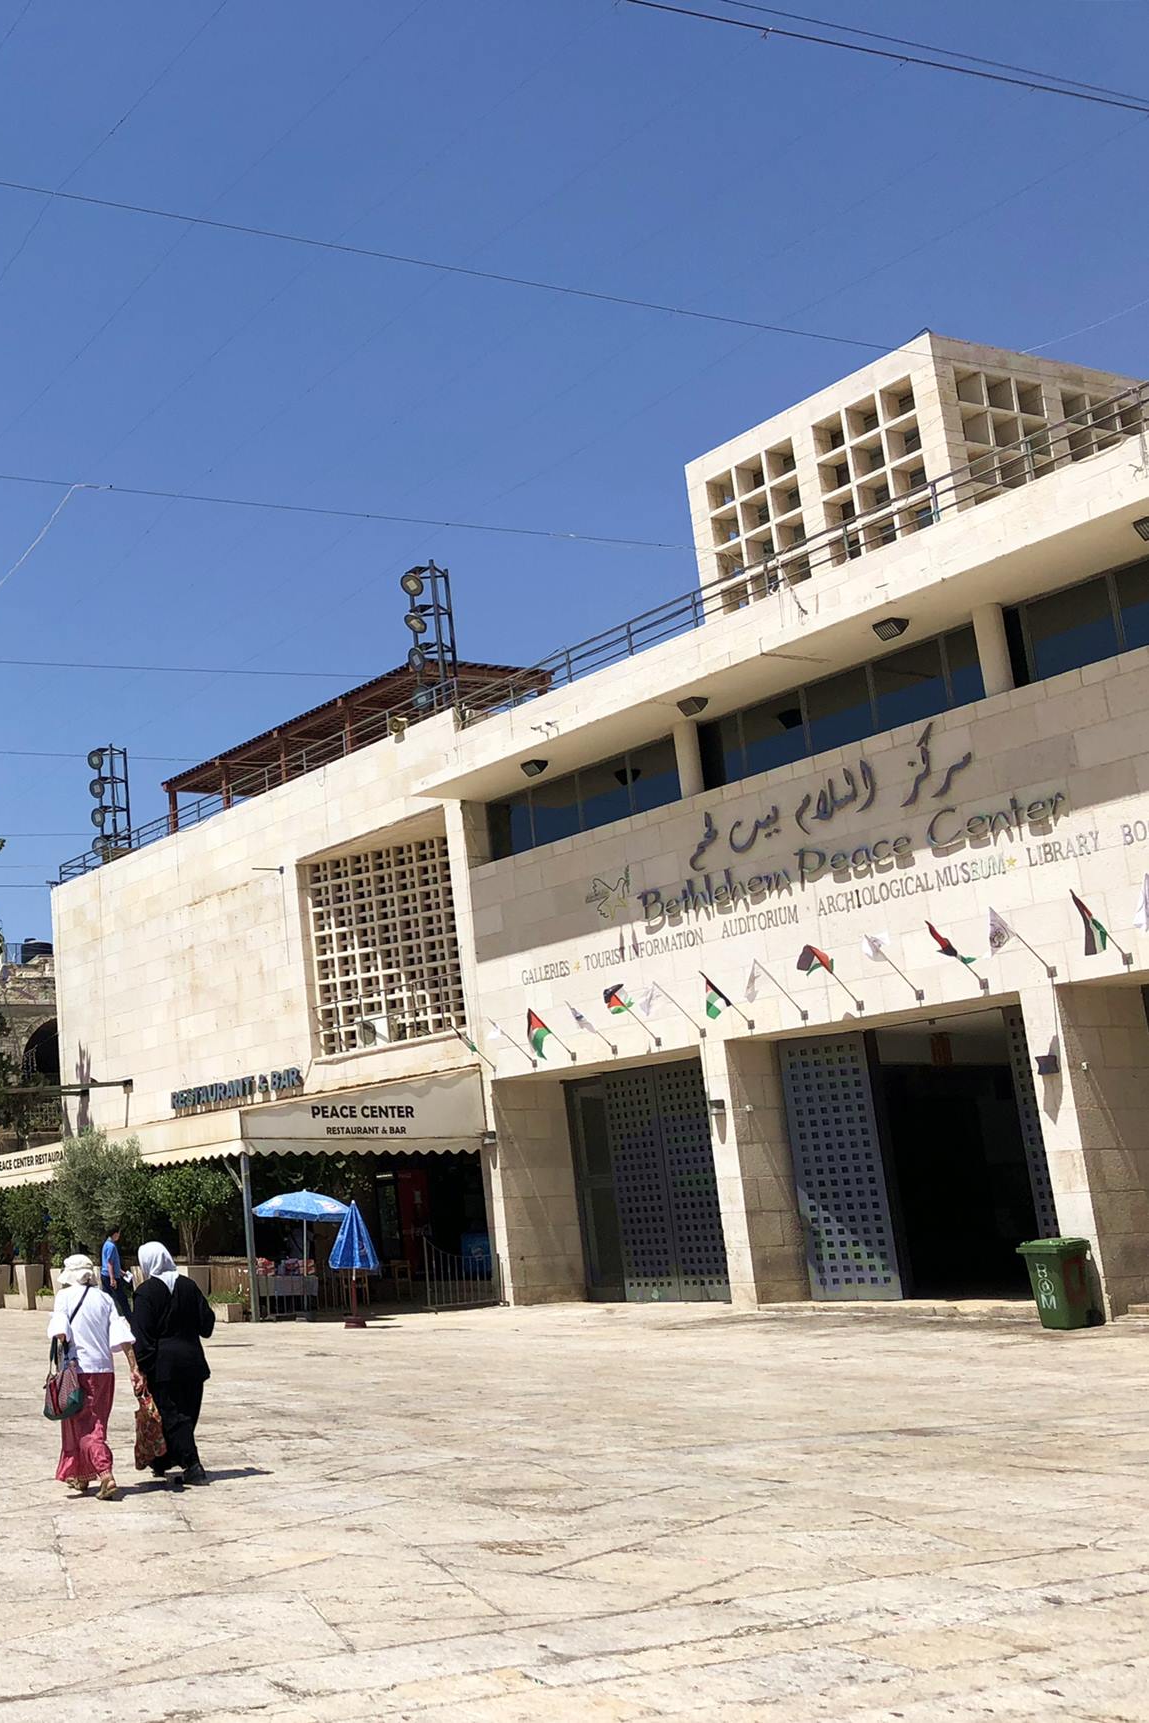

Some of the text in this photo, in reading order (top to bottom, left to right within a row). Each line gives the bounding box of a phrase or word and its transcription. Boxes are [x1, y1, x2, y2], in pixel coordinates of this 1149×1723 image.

[900, 722, 972, 808] مركز
[795, 759, 877, 835] السلام
[638, 791, 1067, 922] Bethlehem Peace Center
[521, 818, 1149, 985] GALLERIES TOURIST INFORMATION AUDITORIUM ARCHIOLOGICAL MUSEUM LIBRARY BO
[171, 1066, 303, 1110] RESTAURANT & BAR
[311, 1105, 415, 1119] PEACE CENTER
[326, 1125, 407, 1135] RESTAURANT & BAR
[13, 1155, 34, 1169] CENTER
